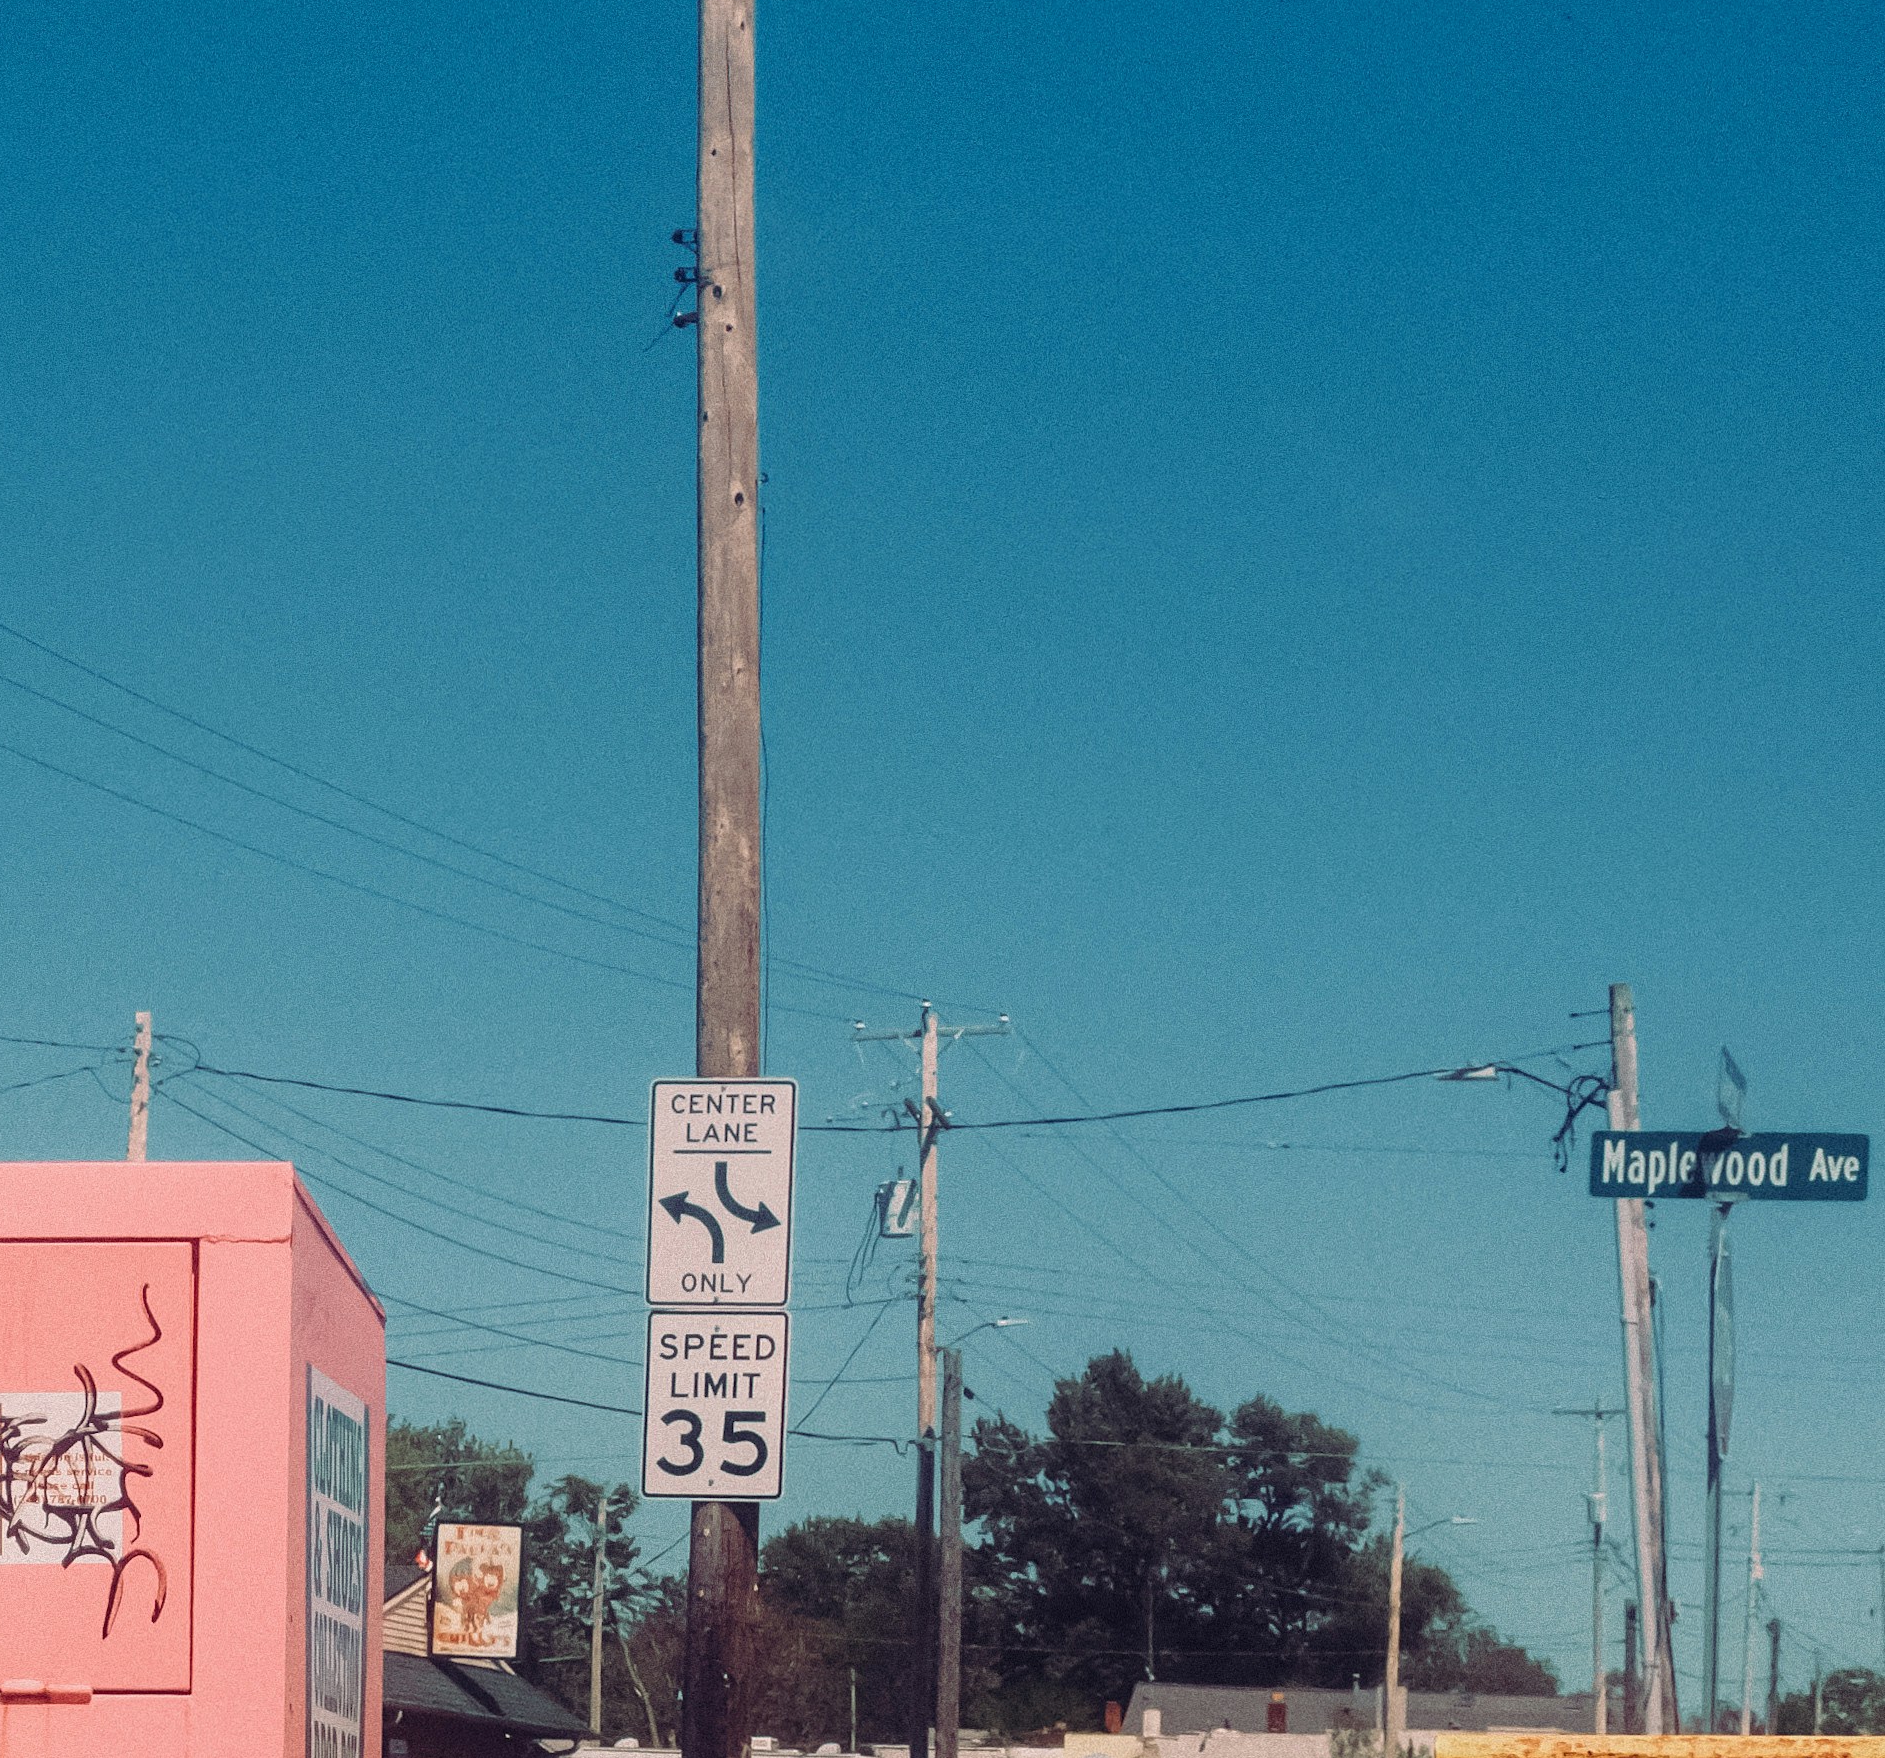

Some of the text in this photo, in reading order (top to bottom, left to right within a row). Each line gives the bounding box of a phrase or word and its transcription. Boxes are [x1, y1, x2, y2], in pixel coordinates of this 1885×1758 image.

[671, 1094, 776, 1115] CENTER
[686, 1123, 758, 1143] LANE
[1809, 1148, 1860, 1182] Ave
[681, 1273, 752, 1294] ONLY
[659, 1334, 776, 1361] SPEED
[671, 1372, 761, 1399] LIMIT
[313, 1392, 362, 1517] CLOTHING
[656, 1409, 769, 1477] 35
[314, 1500, 361, 1617] & SHOES
